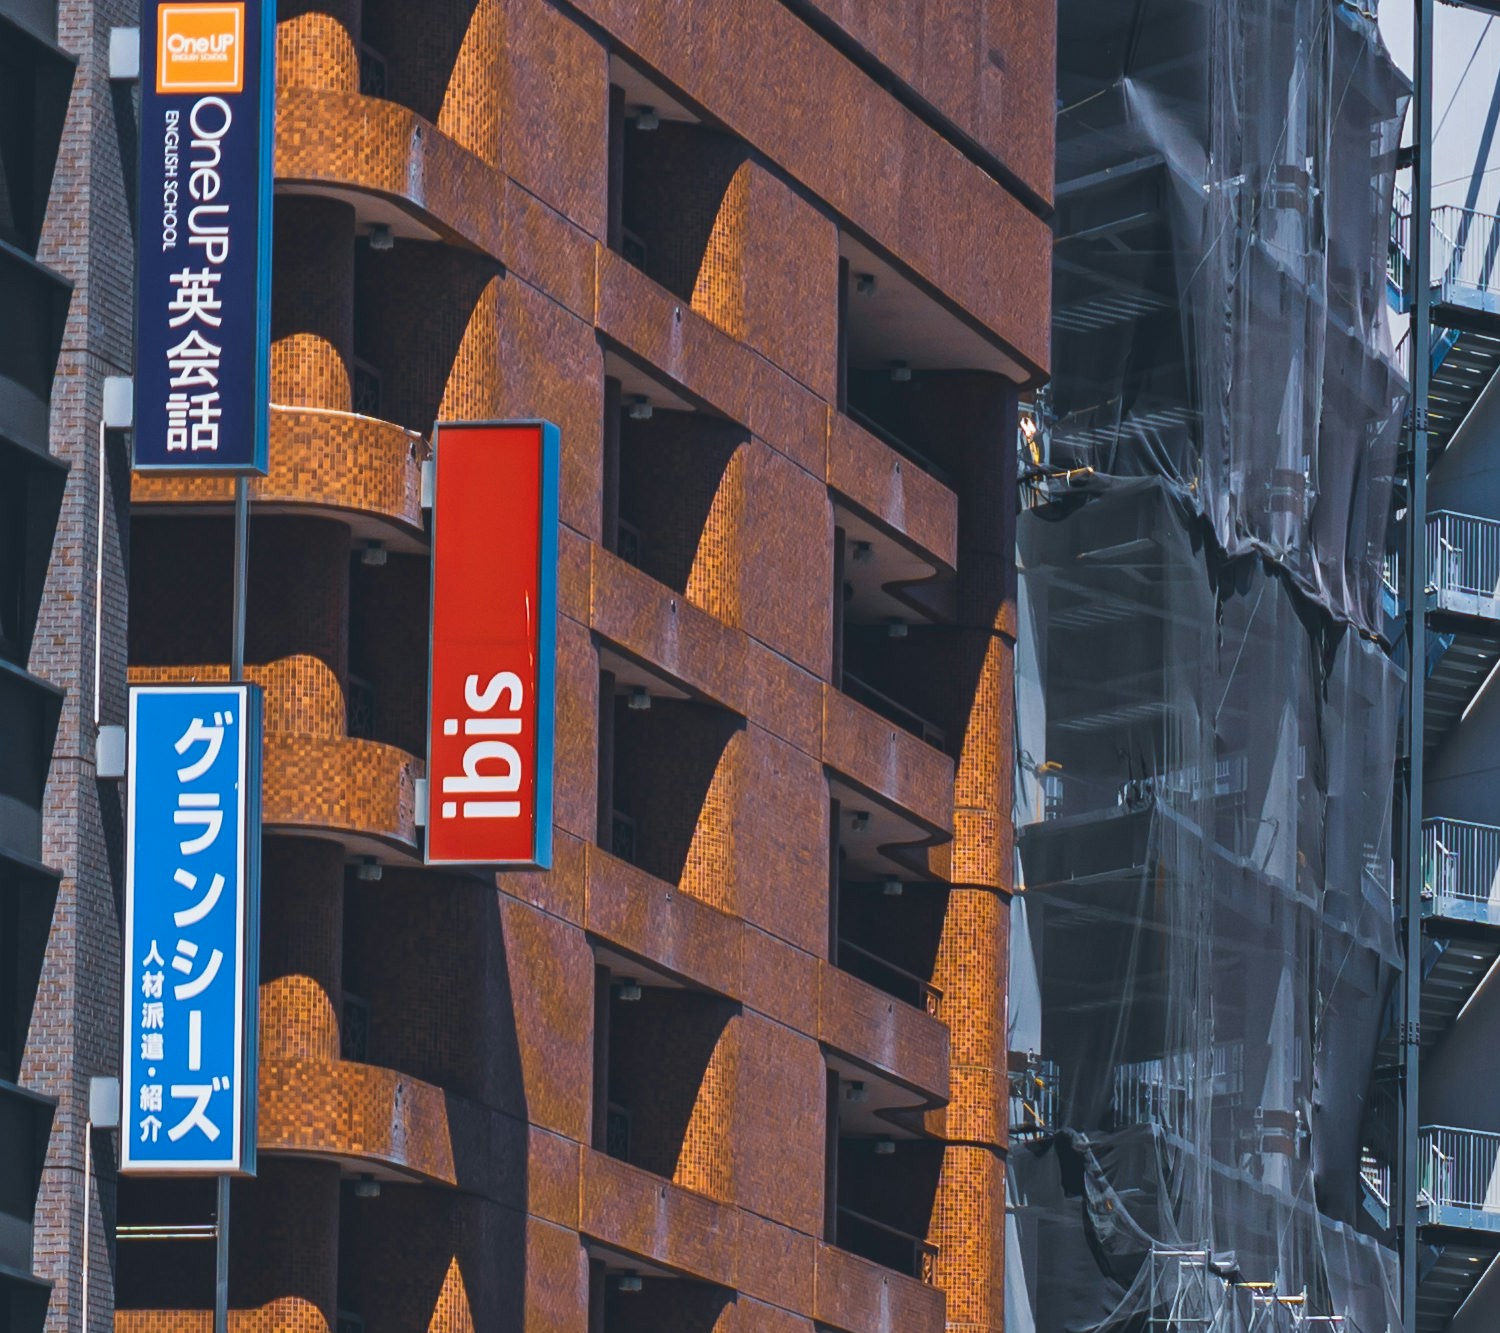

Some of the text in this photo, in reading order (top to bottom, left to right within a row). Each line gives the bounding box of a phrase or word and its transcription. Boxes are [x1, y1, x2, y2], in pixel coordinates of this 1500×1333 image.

[167, 33, 235, 54] OneUP
[162, 110, 179, 251] ENGLISH SCHOOL
[187, 96, 232, 264] OneUP
[165, 267, 223, 452] 英会話
[441, 672, 525, 819] ibis
[168, 710, 233, 1143] グランシーズ
[139, 940, 166, 1143] 人材派遣・紹介
